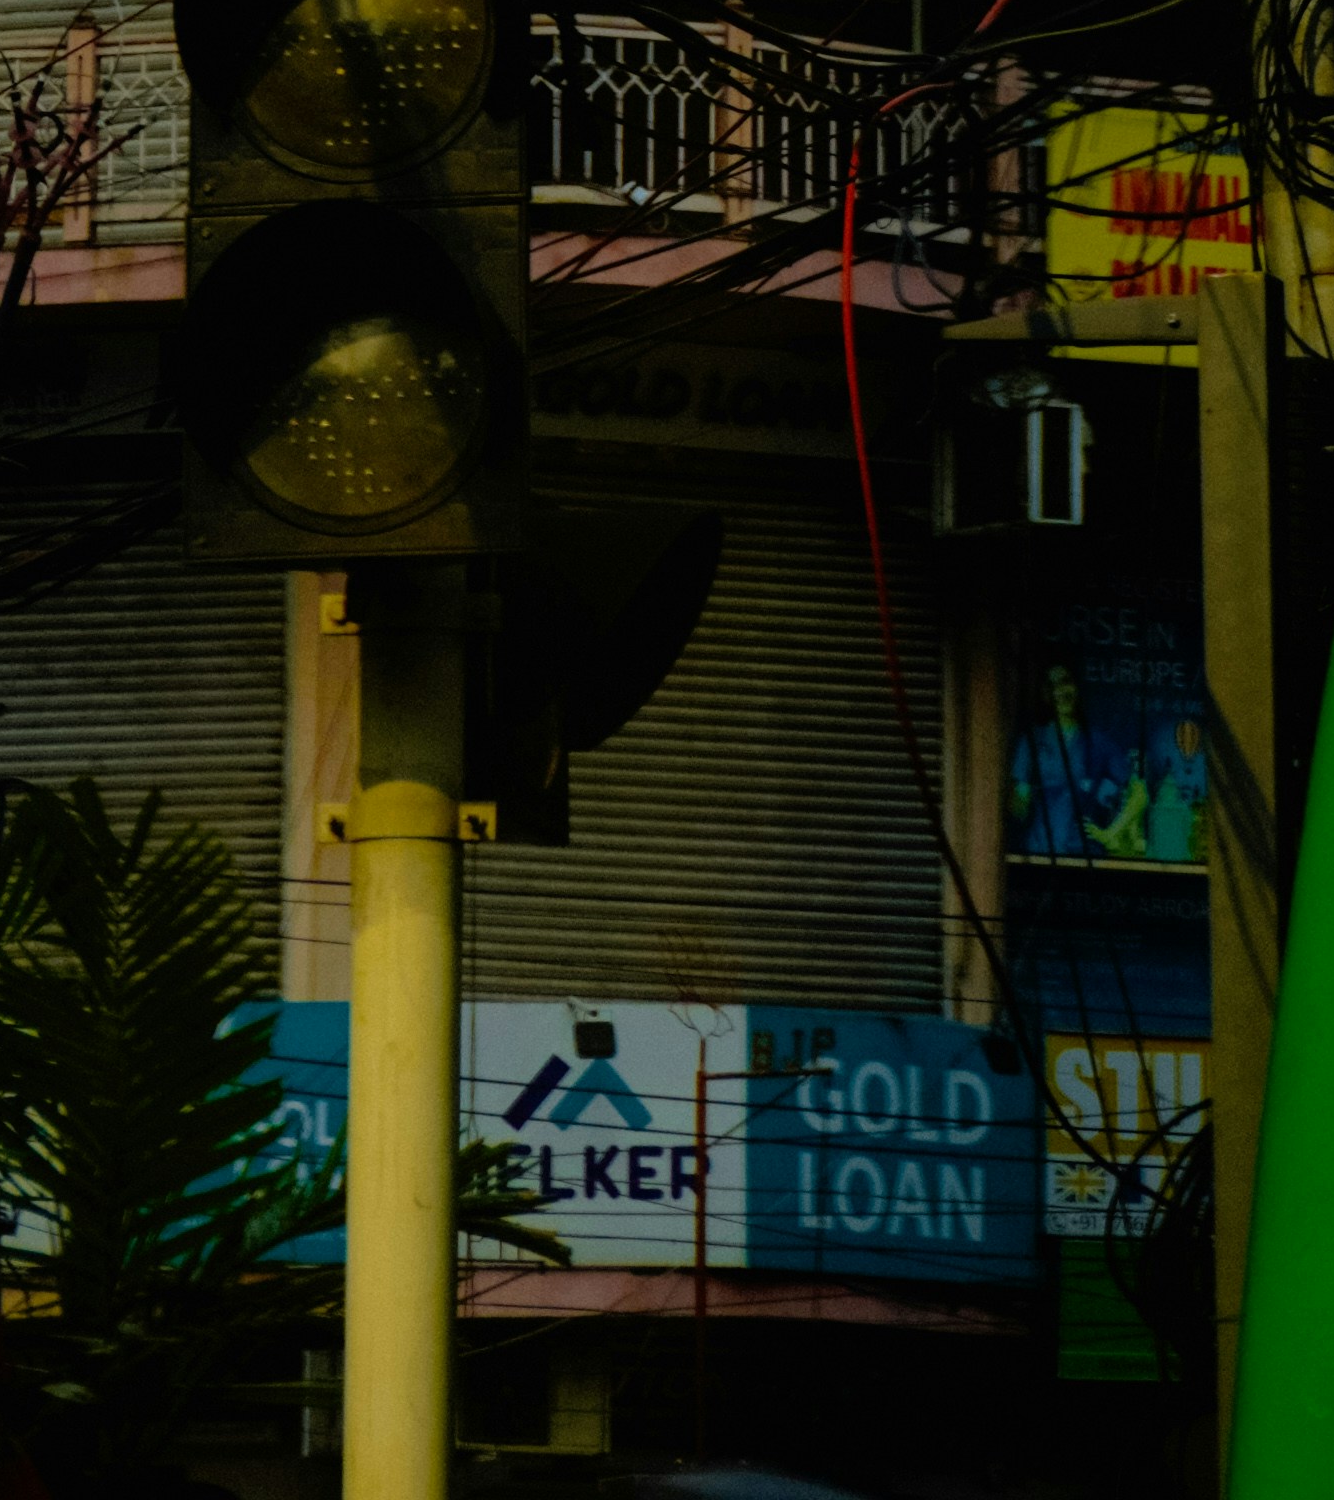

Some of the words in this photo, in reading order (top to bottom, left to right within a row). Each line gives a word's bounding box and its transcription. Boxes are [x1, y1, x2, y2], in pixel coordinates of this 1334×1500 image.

[1083, 654, 1188, 690] EUROPE
[797, 1058, 993, 1146] GOLD
[497, 1143, 710, 1201] ELKER
[798, 1151, 986, 1242] LOAN
